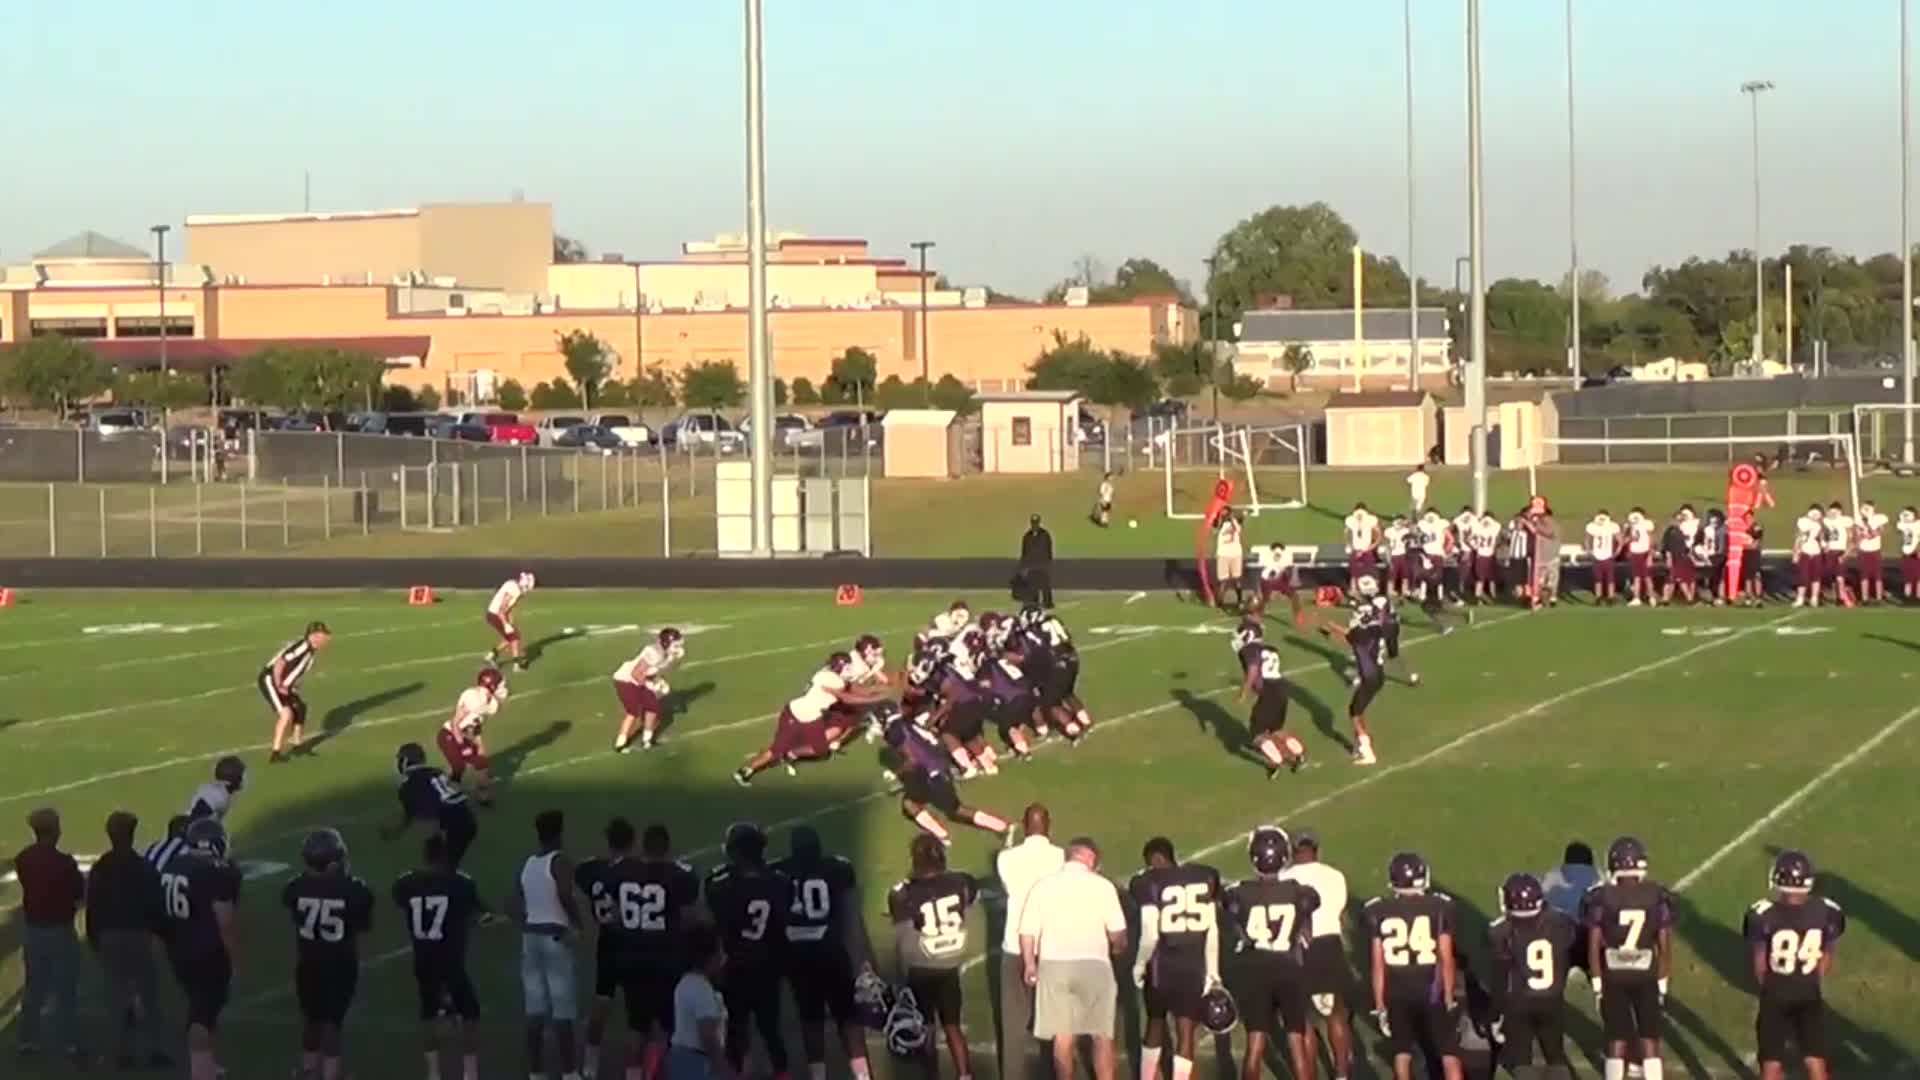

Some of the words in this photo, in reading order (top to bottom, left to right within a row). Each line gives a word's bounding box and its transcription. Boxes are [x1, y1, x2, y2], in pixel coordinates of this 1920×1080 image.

[161, 874, 190, 920] 76
[297, 898, 346, 942] 75
[410, 896, 448, 940] 17
[619, 881, 666, 931] 62
[741, 899, 771, 941] 3
[919, 894, 963, 937] 15
[1160, 883, 1211, 933] 25
[1246, 904, 1297, 952] 47
[1379, 914, 1437, 966] 24
[1618, 909, 1647, 955] 7
[1525, 939, 1555, 991] 9
[1770, 928, 1824, 975] 84
